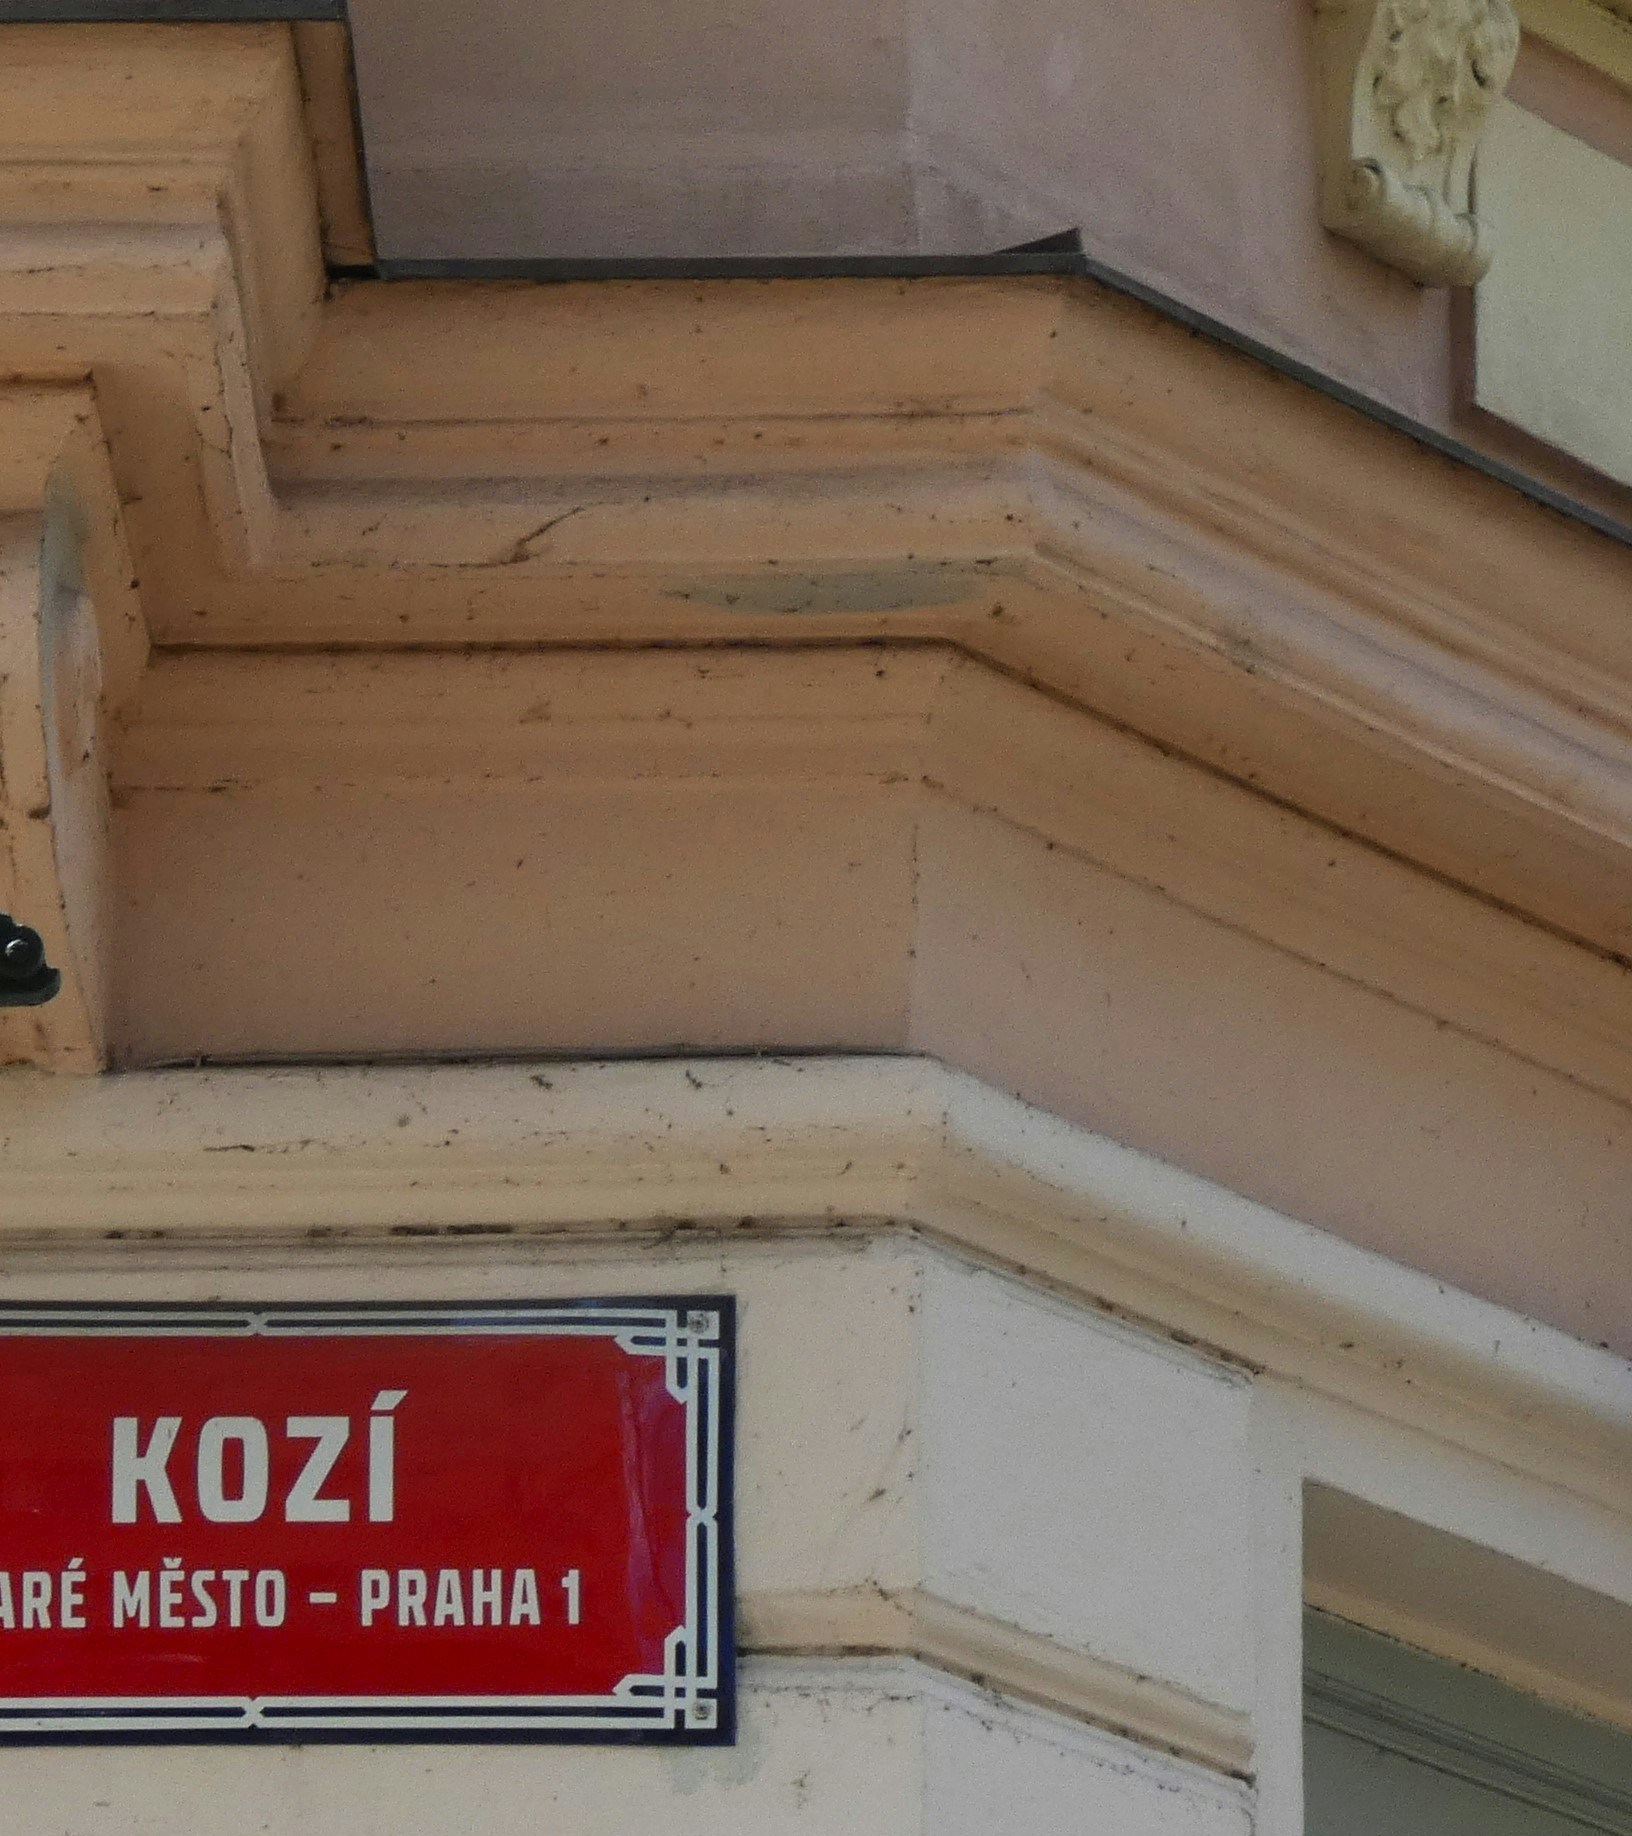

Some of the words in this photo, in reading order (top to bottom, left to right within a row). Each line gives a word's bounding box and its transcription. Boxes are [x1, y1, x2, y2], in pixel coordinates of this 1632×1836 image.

[112, 1390, 407, 1523] KOZÍ
[113, 1557, 285, 1627] MĚSTO
[361, 1569, 540, 1626] PRAHA
[562, 1569, 579, 1624] 1
